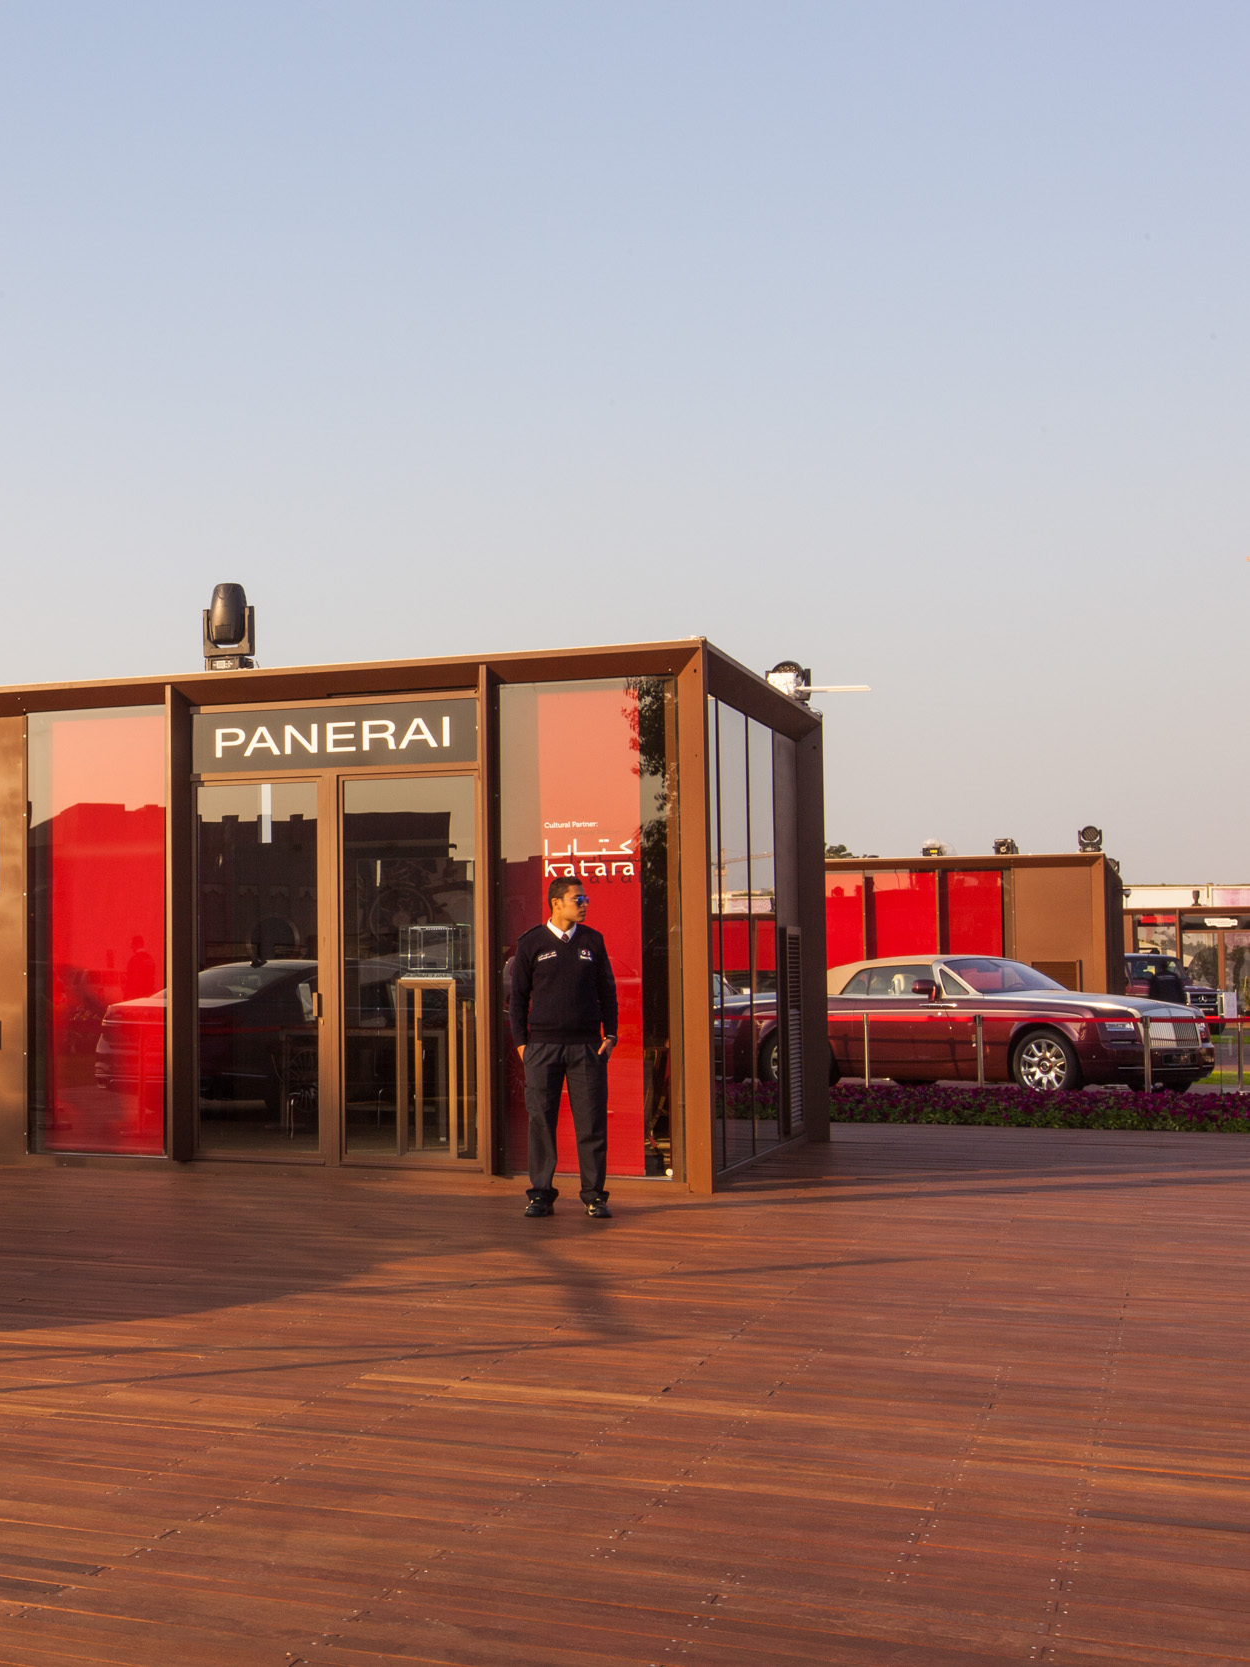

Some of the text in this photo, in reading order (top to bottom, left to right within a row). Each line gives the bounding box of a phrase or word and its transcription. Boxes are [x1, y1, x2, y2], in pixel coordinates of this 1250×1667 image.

[215, 716, 450, 758] PANERAI
[544, 838, 634, 857] كتارا
[544, 860, 635, 877] katara
